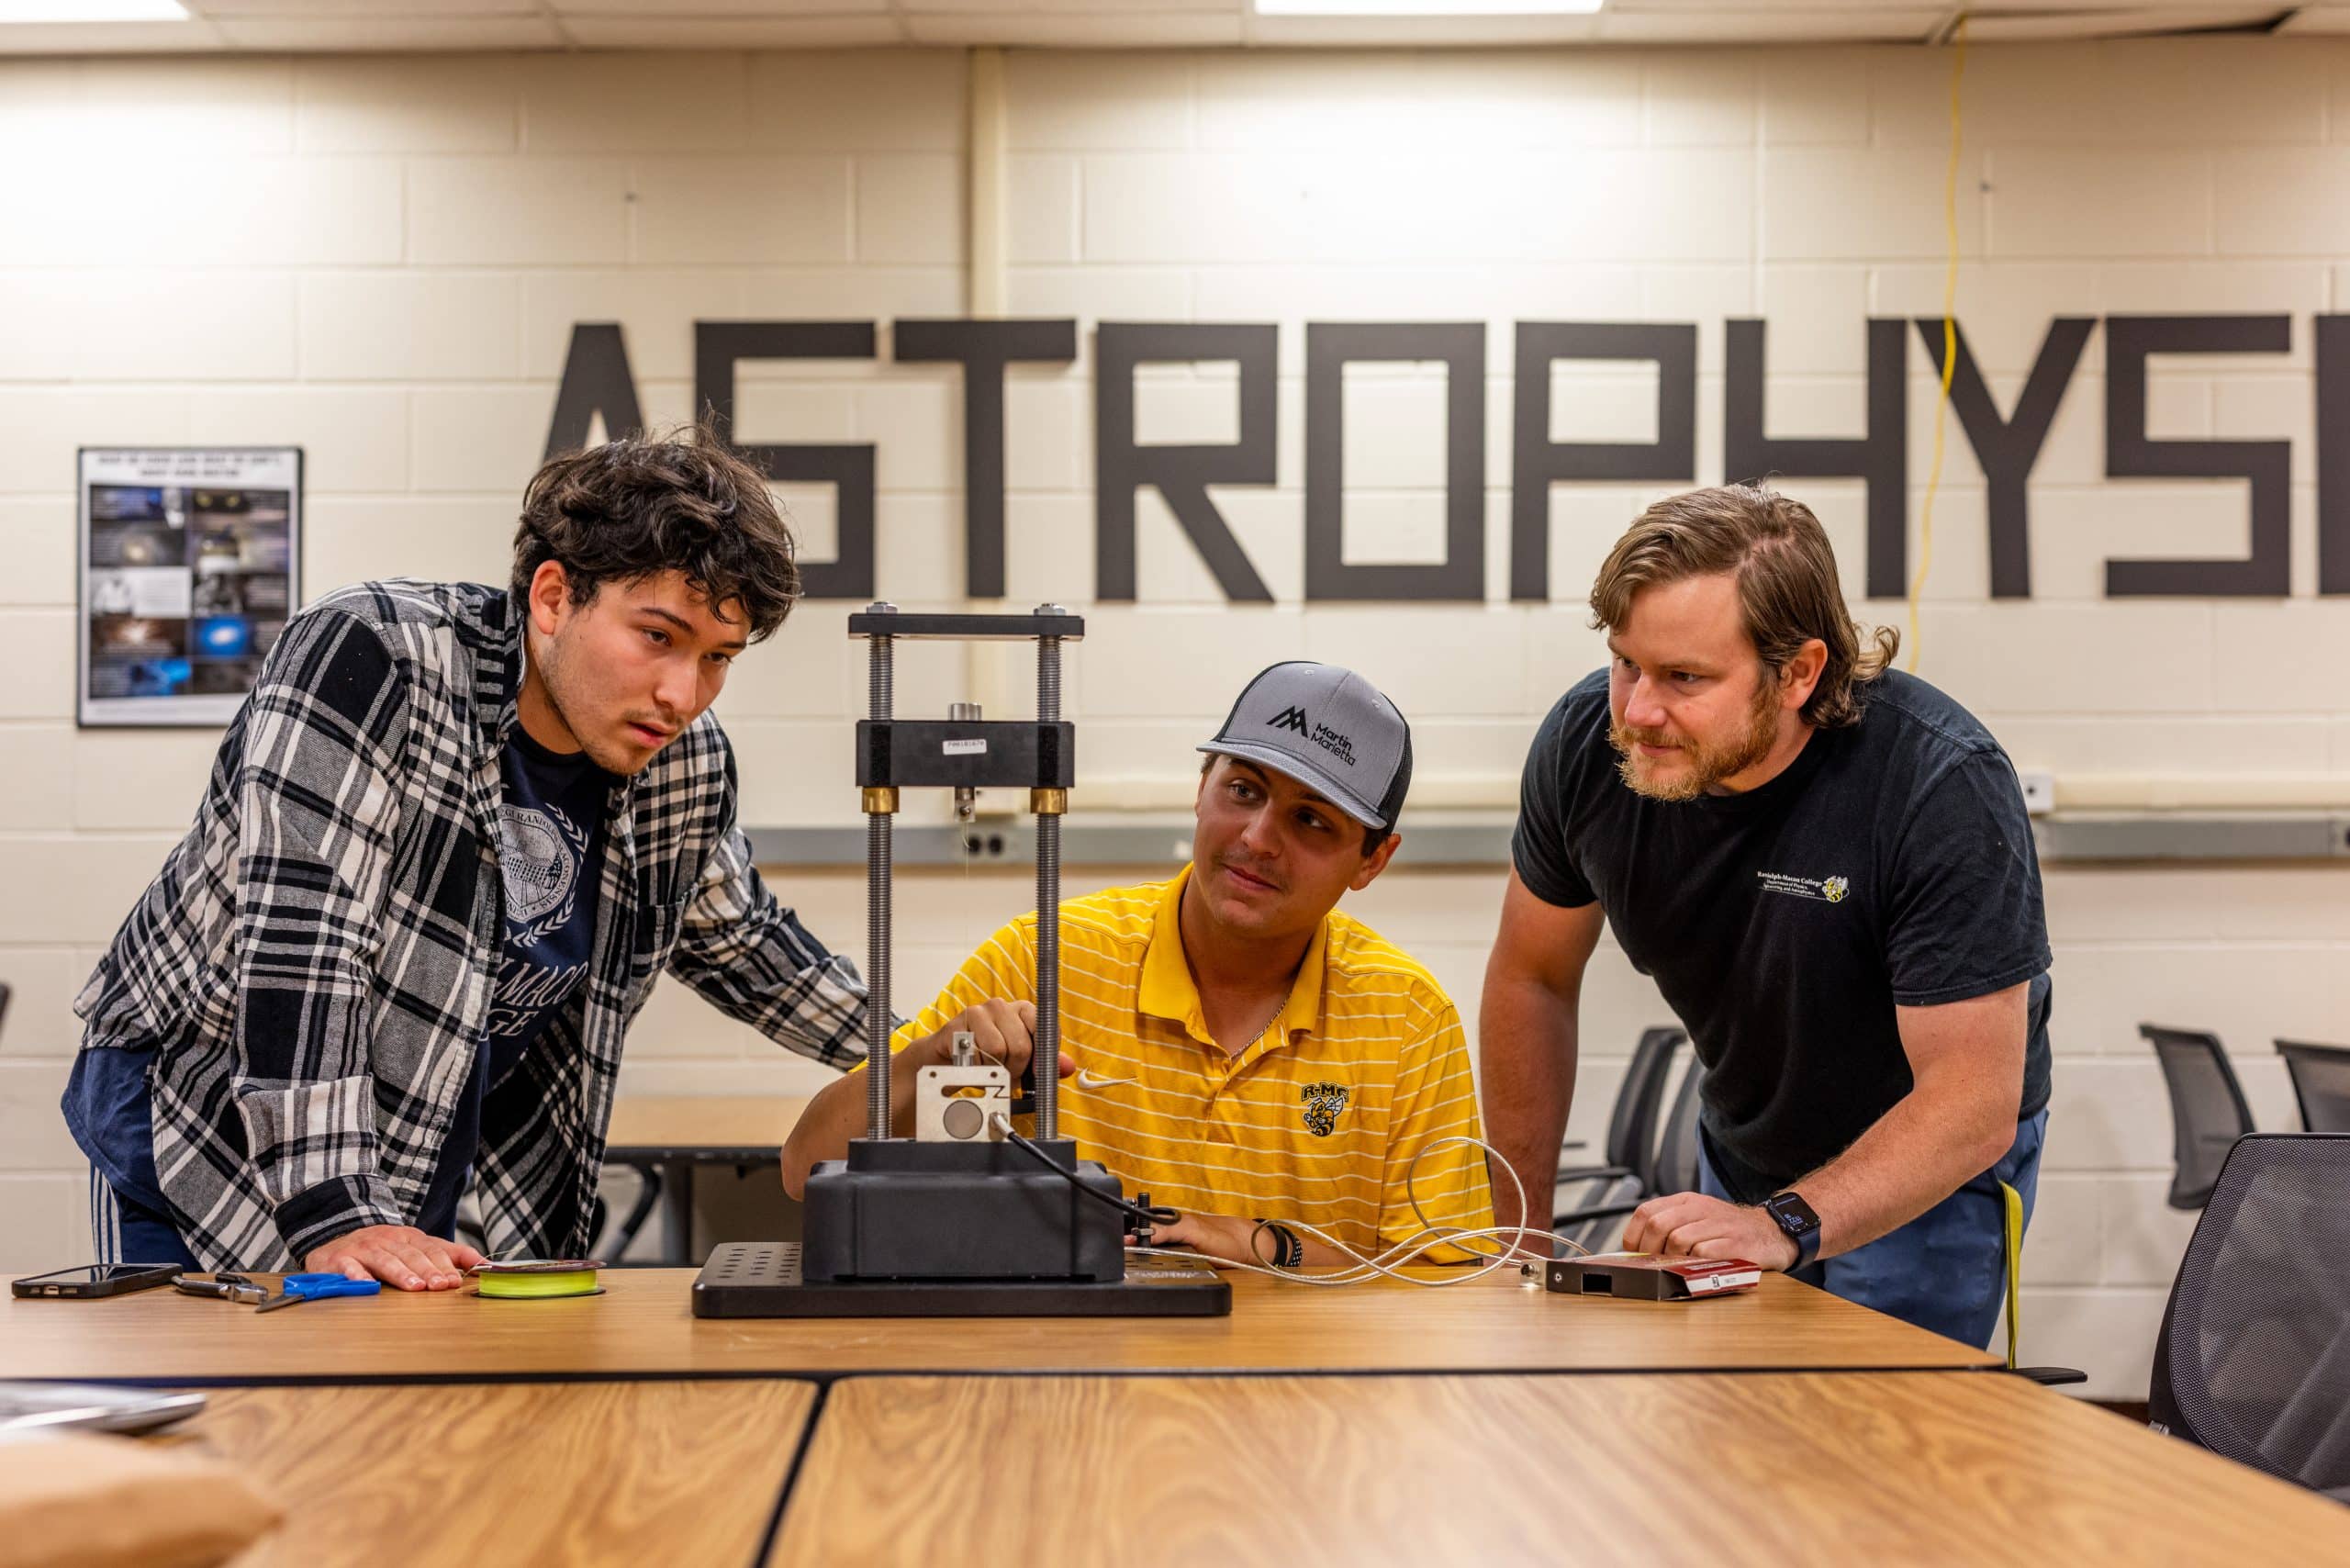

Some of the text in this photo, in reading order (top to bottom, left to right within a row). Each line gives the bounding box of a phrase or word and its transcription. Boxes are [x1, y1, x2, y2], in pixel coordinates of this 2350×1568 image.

[1310, 733, 1356, 767] Marietta
[1315, 722, 1352, 752] Martin
[1302, 1082, 1349, 1103] R-MC
